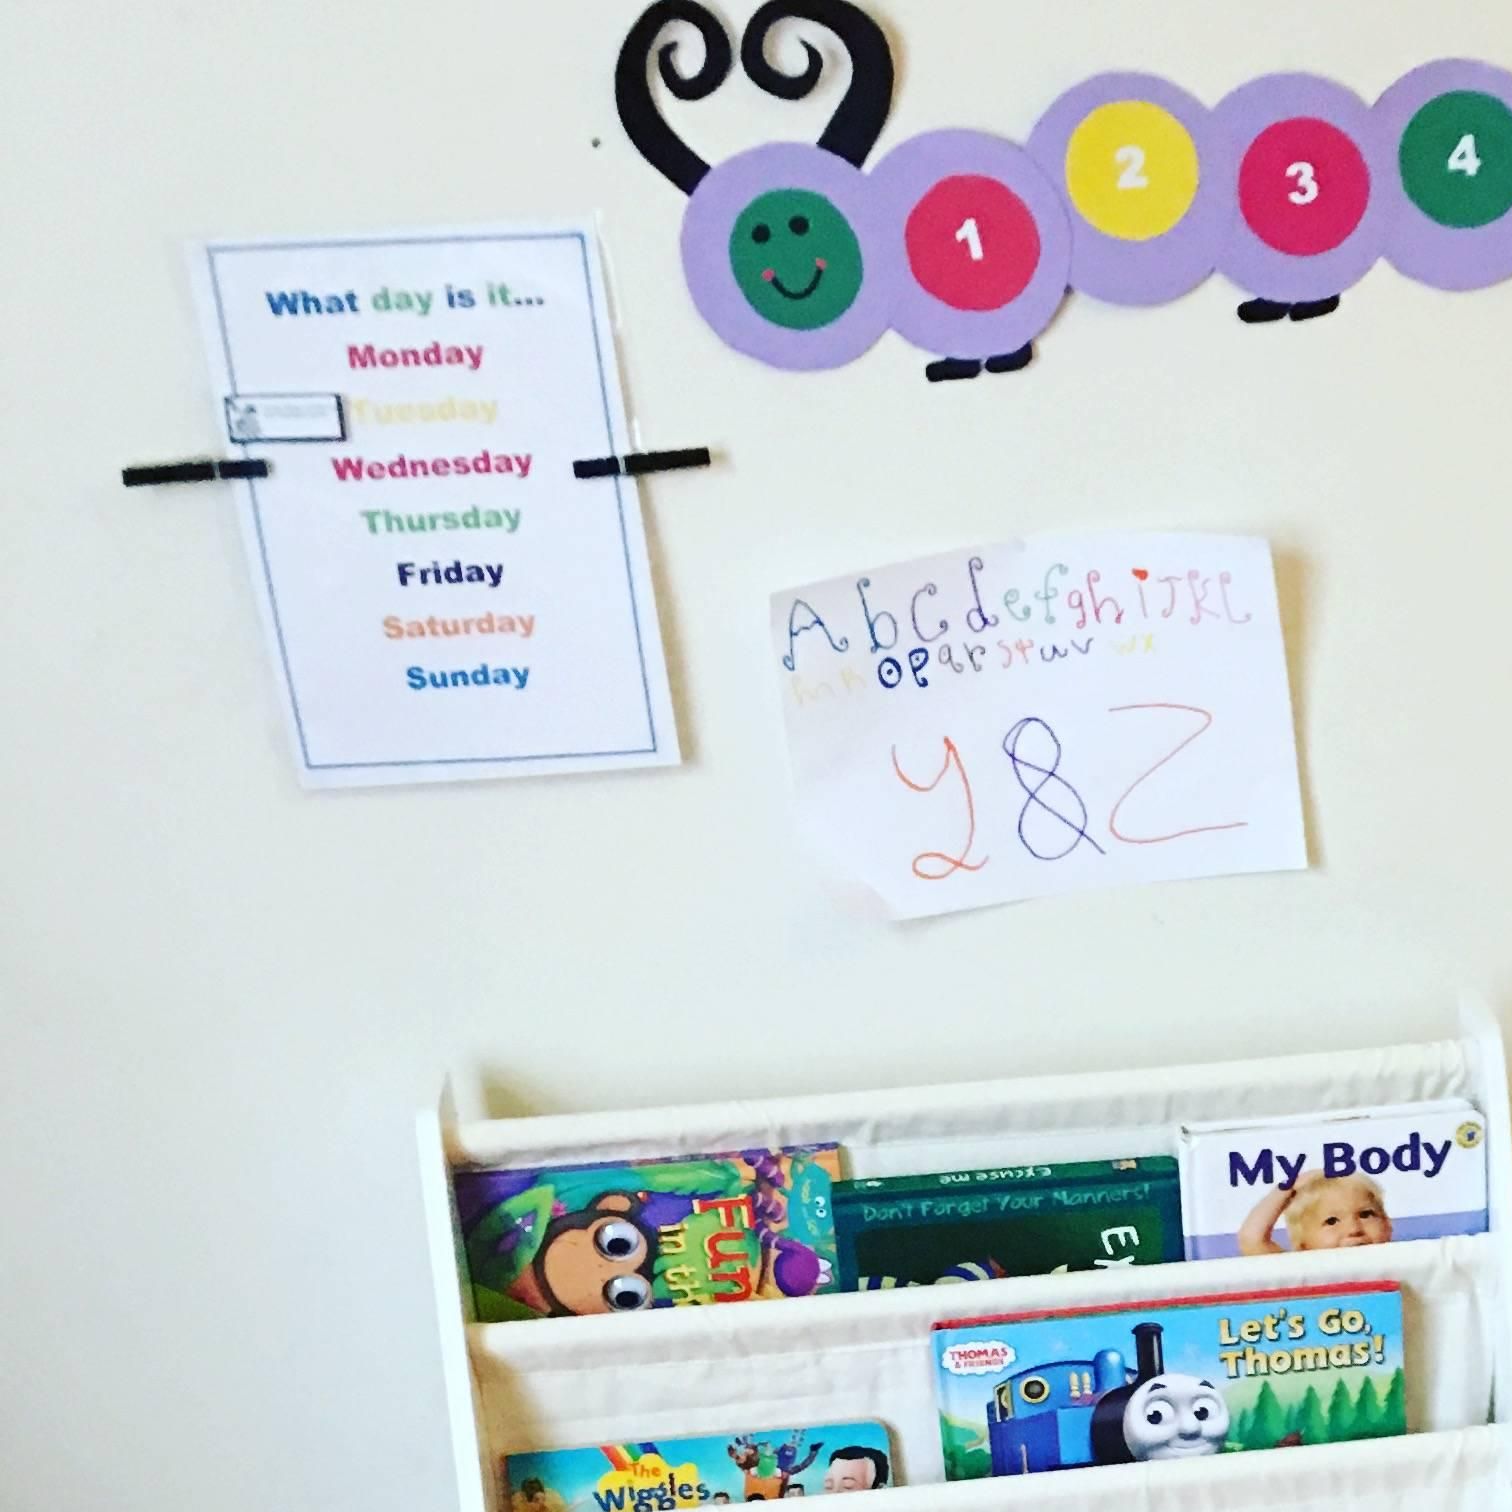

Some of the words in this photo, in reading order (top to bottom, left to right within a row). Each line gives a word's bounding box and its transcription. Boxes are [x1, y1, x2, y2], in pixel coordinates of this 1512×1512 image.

[1115, 147, 1147, 190] 2
[1447, 134, 1482, 176] 4
[1286, 162, 1319, 205] 3
[955, 220, 985, 262] 1
[266, 288, 360, 317] What
[372, 286, 433, 317] day
[447, 285, 476, 309] is
[347, 342, 484, 370] Monday
[352, 397, 498, 425] Tuesday
[332, 452, 533, 481] Wednesday
[361, 506, 522, 536] Thursday
[397, 560, 504, 589] Friday
[382, 612, 536, 641] Saturday
[406, 664, 531, 692] Sunday
[1228, 1148, 1306, 1191] My
[1323, 1131, 1452, 1179] Body
[939, 1170, 970, 1185] me
[863, 1201, 913, 1222] Don't
[921, 1197, 989, 1219] Forget
[999, 1194, 1040, 1210] Your
[1052, 1183, 1151, 1206] Manners!
[658, 1223, 687, 1254] in
[692, 1194, 754, 1303] Fun
[1218, 1307, 1305, 1346] Let's
[1317, 1308, 1372, 1336] Go,
[949, 1347, 1008, 1360] THOMAS
[1219, 1334, 1385, 1379] Thomas!
[629, 1463, 661, 1478] The
[592, 1472, 710, 1512] Wiggles
